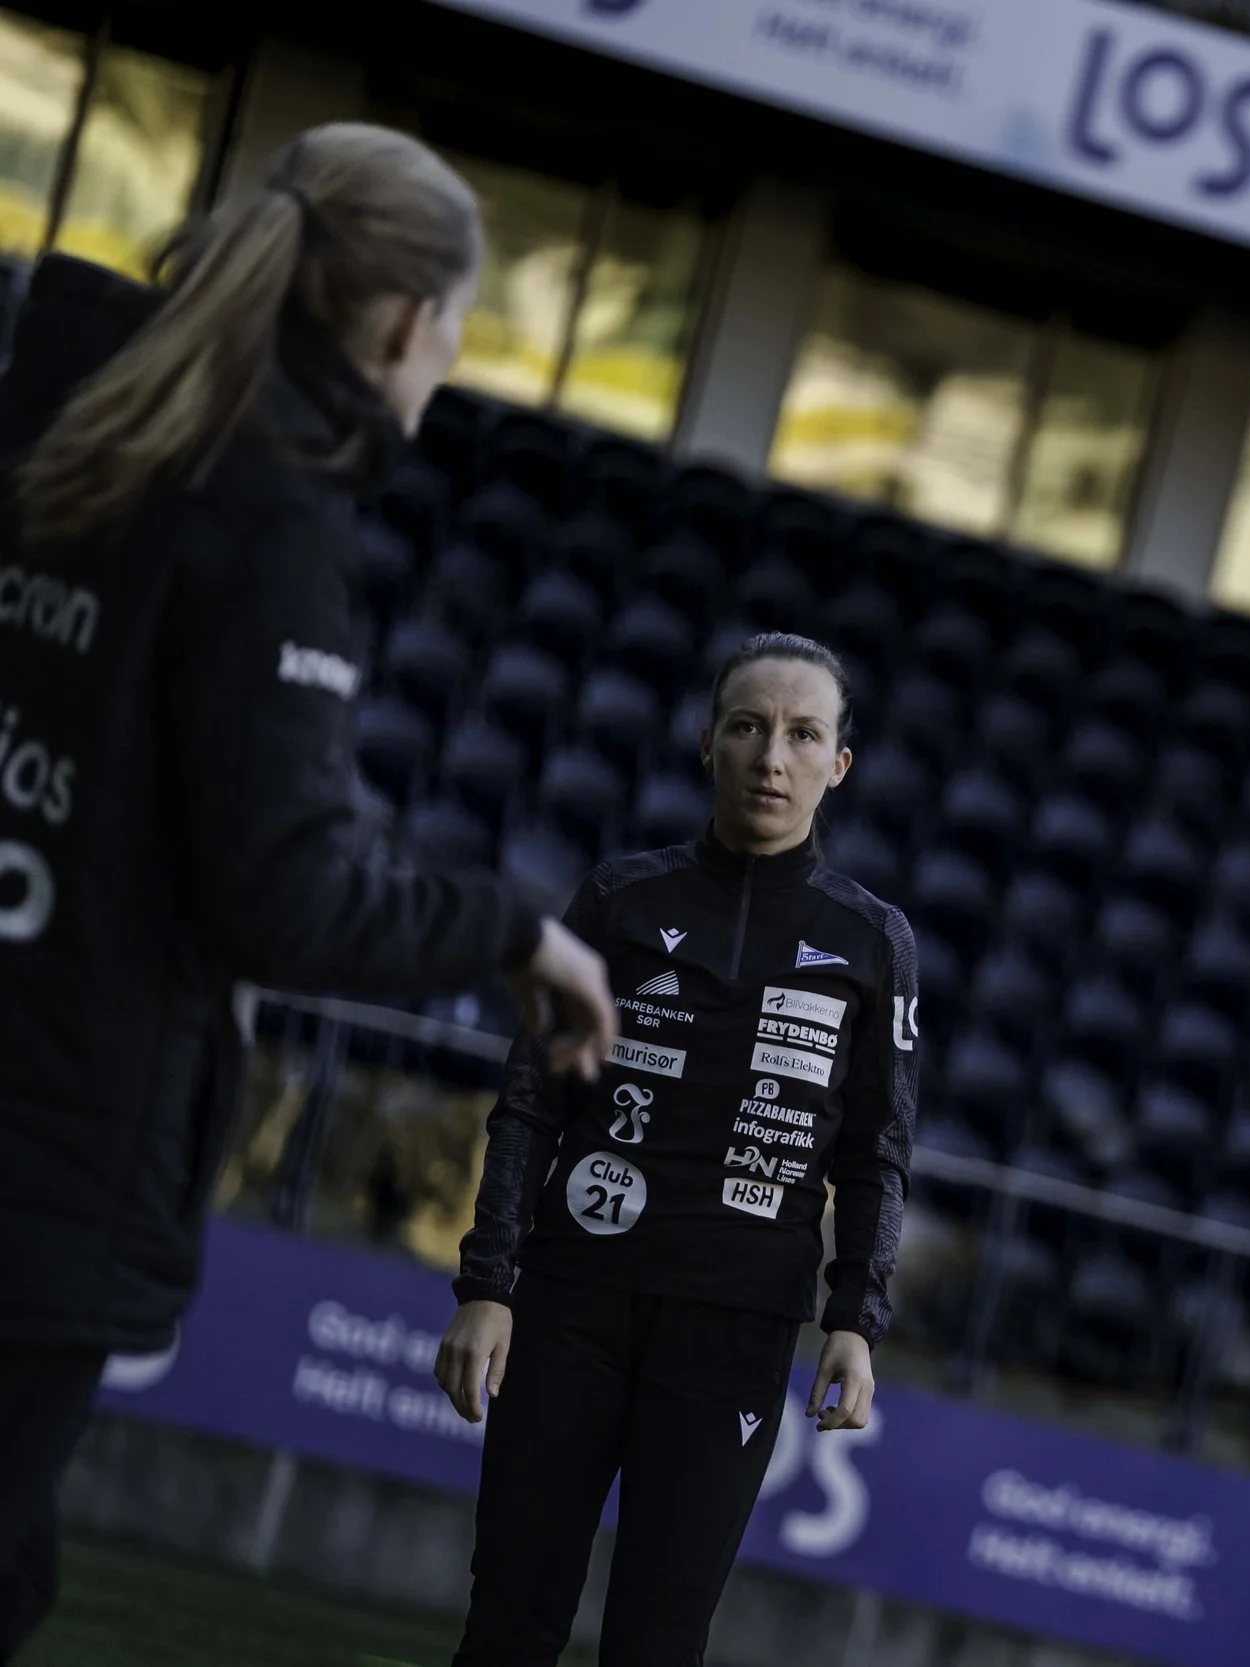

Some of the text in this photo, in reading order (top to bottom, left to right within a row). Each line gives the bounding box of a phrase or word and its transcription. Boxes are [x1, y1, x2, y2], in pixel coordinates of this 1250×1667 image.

[615, 997, 694, 1023] SPAREBANKEN
[636, 1014, 660, 1028] SØR
[758, 1018, 838, 1048] FRYDENBØ
[612, 1043, 678, 1069] murisør
[791, 1058, 825, 1077] Elektro
[761, 1082, 775, 1095] PB
[732, 1117, 815, 1149] infografikk
[590, 1160, 633, 1188] Club
[581, 1185, 626, 1225] 21
[731, 1182, 774, 1208] HSH
